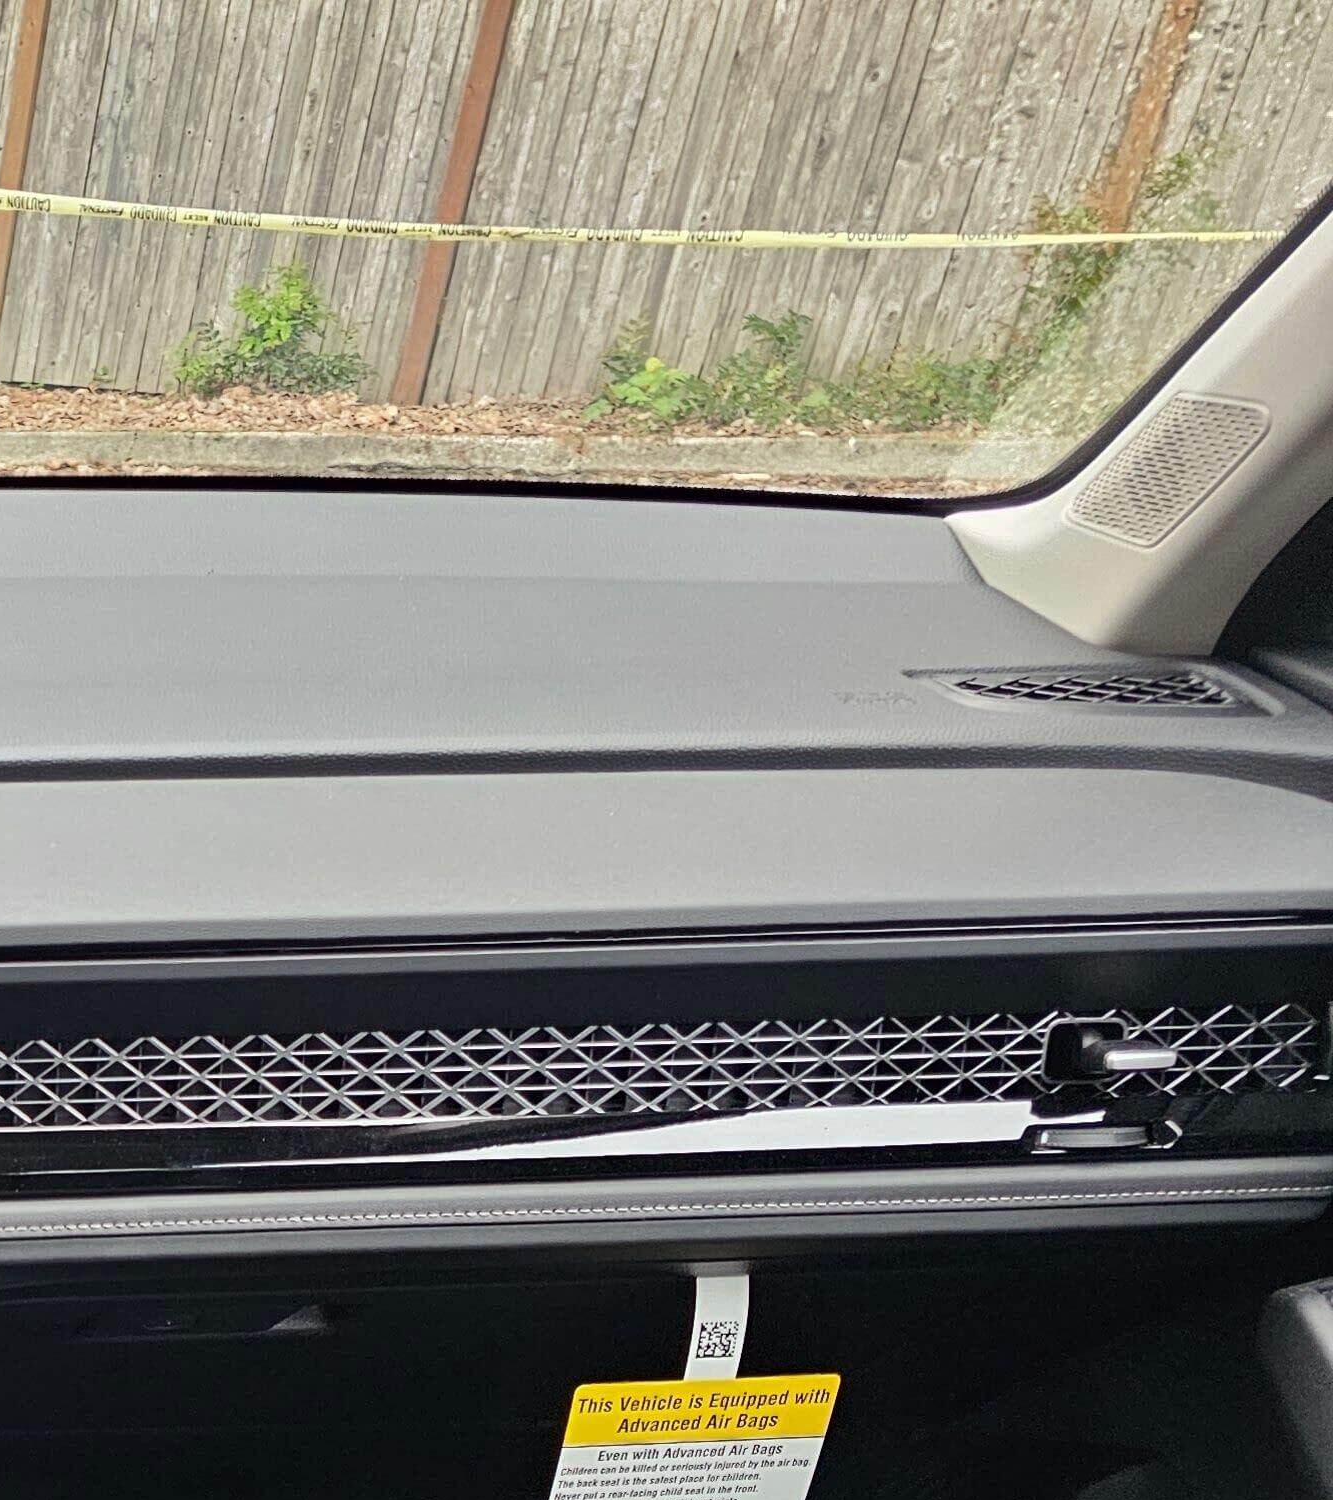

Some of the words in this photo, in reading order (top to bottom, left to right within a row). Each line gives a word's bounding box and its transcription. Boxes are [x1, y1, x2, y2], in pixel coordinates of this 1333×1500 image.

[7, 194, 51, 212] CAUTION
[130, 206, 177, 222] CUIDADO
[213, 209, 261, 227] CAUTION
[578, 1398, 613, 1413] This
[620, 1395, 682, 1411] Vehicle
[689, 1394, 703, 1409] is
[709, 1390, 789, 1410] Equipped
[794, 1388, 830, 1404] with
[617, 1415, 701, 1433] Advanced
[705, 1414, 732, 1429] Air
[736, 1413, 778, 1430] Bags
[598, 1450, 628, 1461] Even
[633, 1448, 660, 1460] with
[662, 1445, 725, 1459] Advanced
[729, 1444, 748, 1456] Air
[751, 1444, 783, 1456] Bags
[560, 1466, 598, 1476] Children
[600, 1467, 616, 1475] can
[619, 1465, 630, 1473] be
[632, 1464, 657, 1473] killed
[672, 1461, 712, 1472] seriously
[714, 1460, 745, 1470] injured
[748, 1460, 758, 1469] by
[761, 1459, 775, 1467] the
[777, 1459, 790, 1467] air
[792, 1458, 811, 1468] bag.
[558, 1480, 574, 1489] The
[576, 1478, 597, 1487] back
[600, 1478, 620, 1487] seat
[622, 1477, 630, 1486] is
[632, 1476, 649, 1485] the
[679, 1475, 704, 1485] place
[706, 1473, 719, 1482] for
[721, 1472, 761, 1482] children.
[554, 1493, 581, 1500] Never
[582, 1491, 598, 1500] put
[660, 1487, 683, 1497] child
[685, 1486, 704, 1495] seat
[706, 1485, 715, 1494] in
[718, 1485, 732, 1493] the
